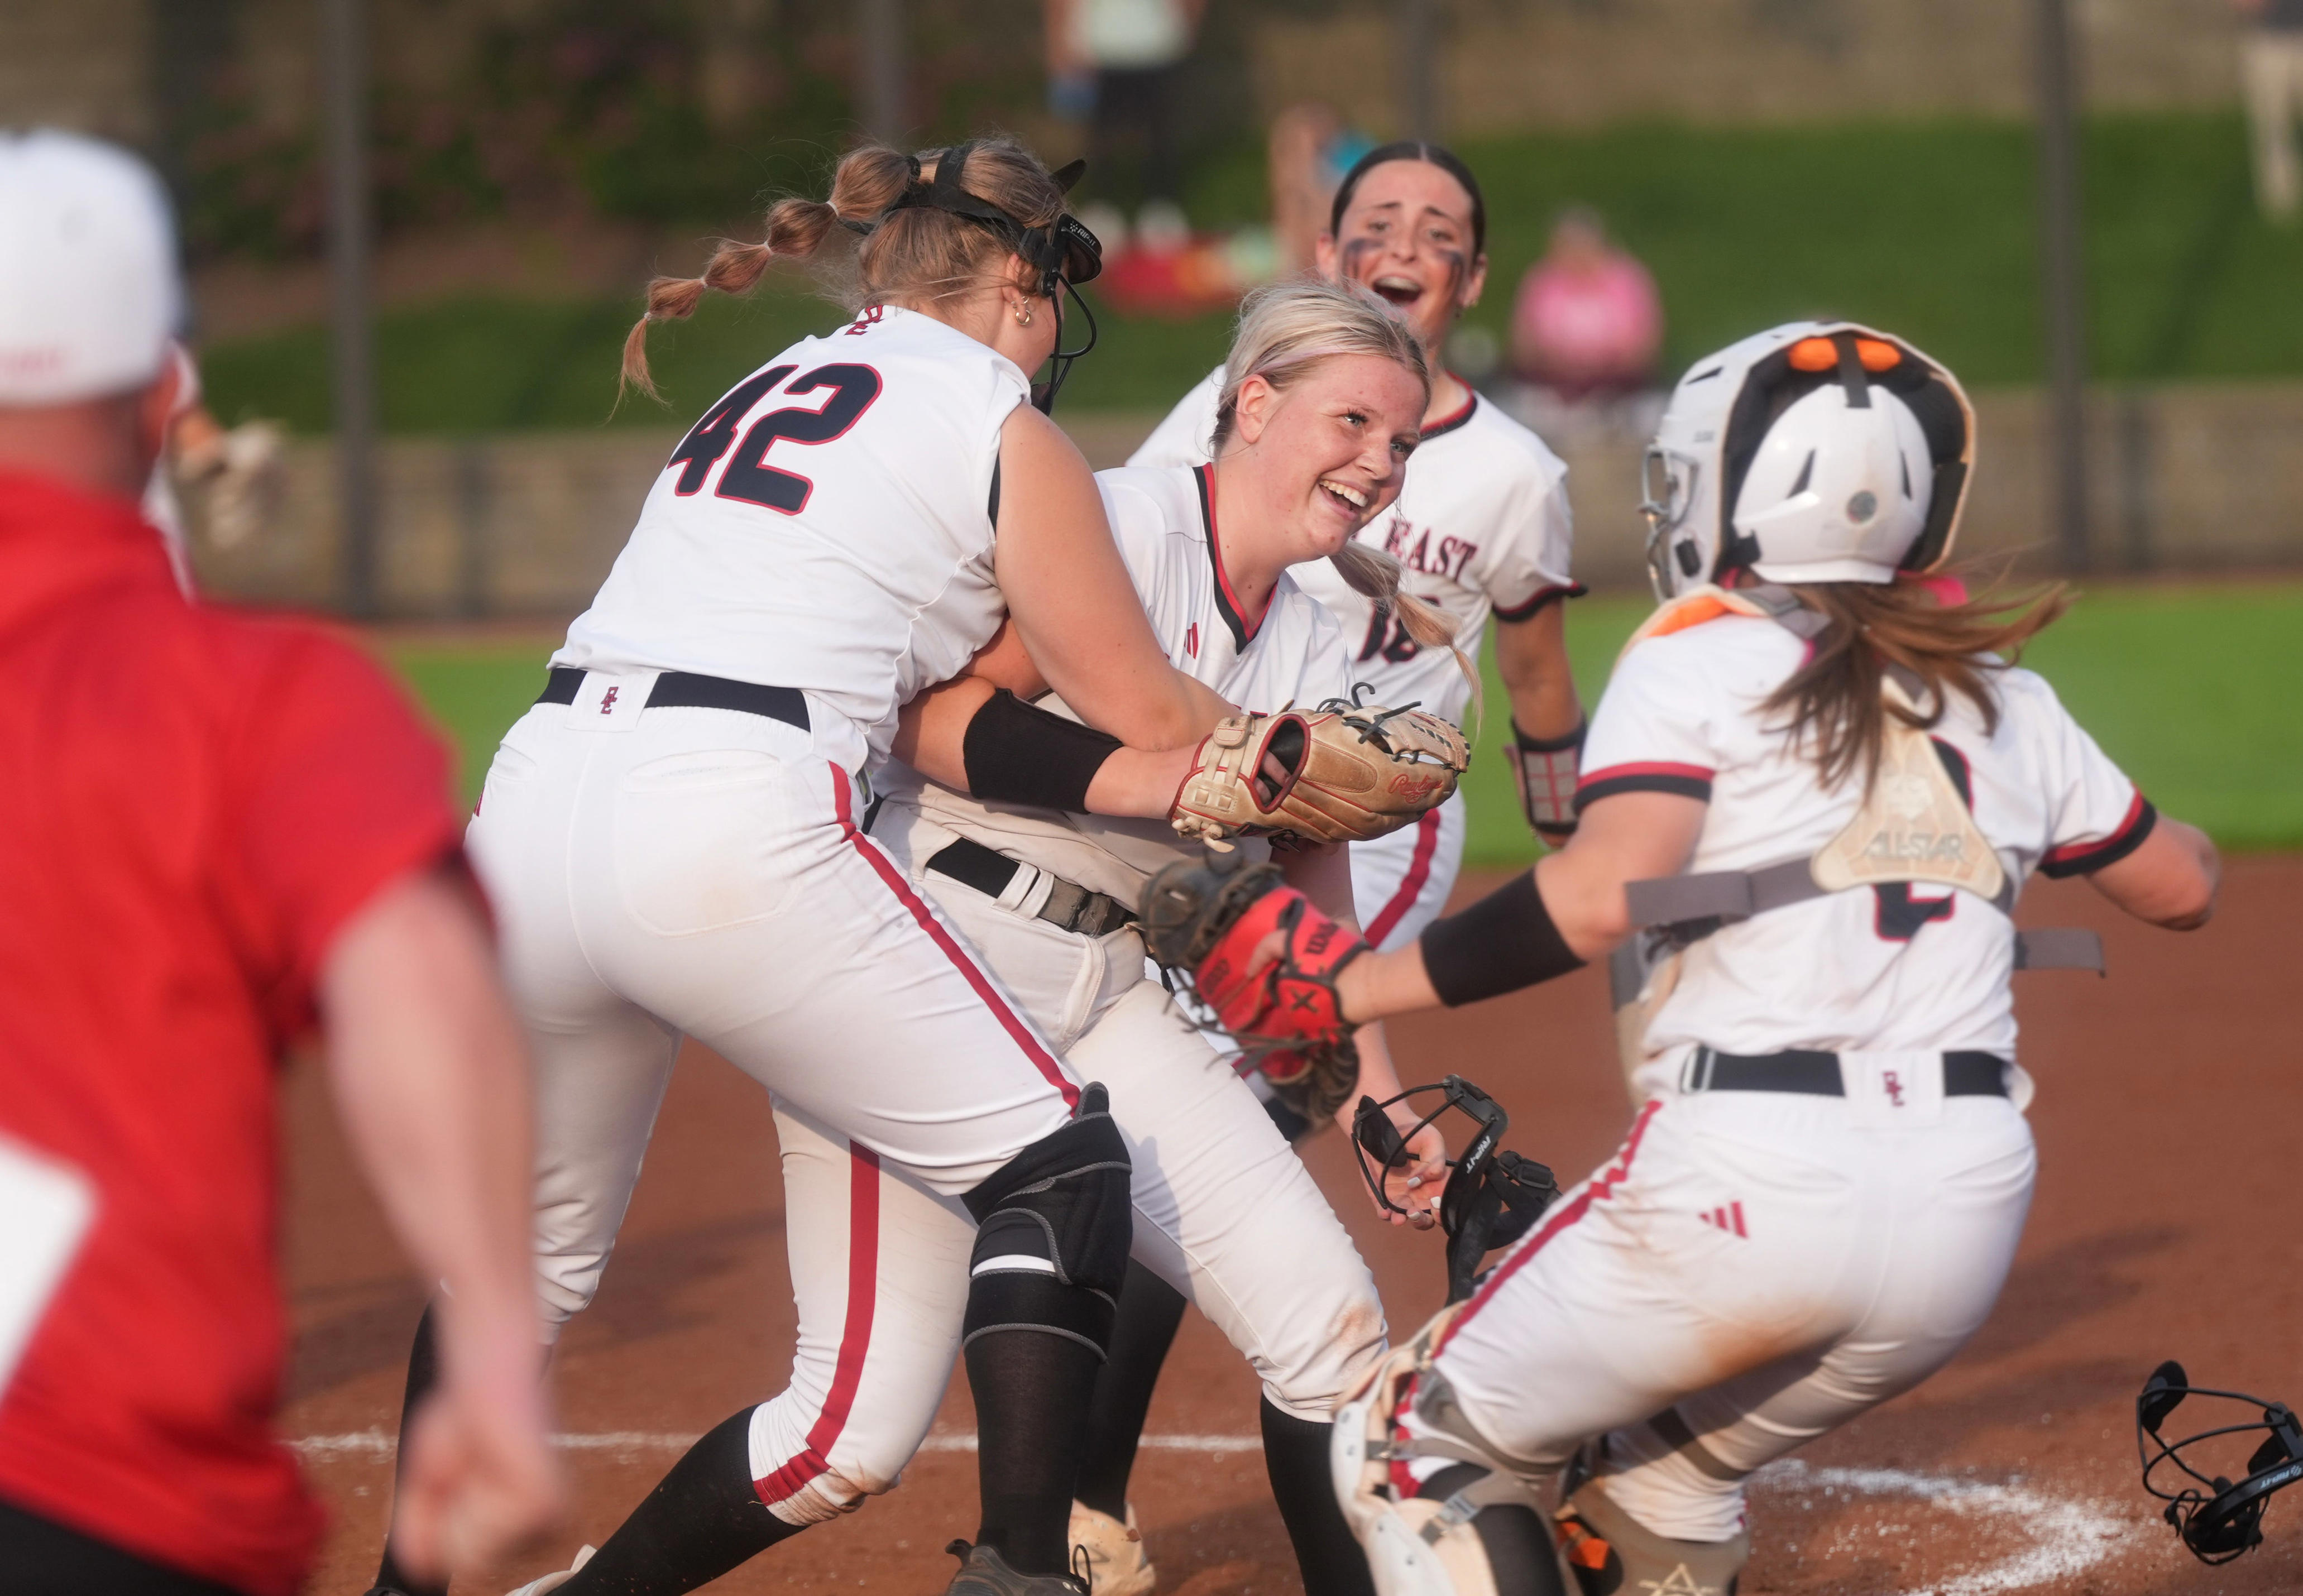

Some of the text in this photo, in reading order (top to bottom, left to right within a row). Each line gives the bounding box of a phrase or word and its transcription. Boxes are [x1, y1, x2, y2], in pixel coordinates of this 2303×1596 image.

[1077, 228, 1096, 246] RIP-IT
[667, 362, 883, 516] 42
[1383, 518, 1478, 582] EAST
